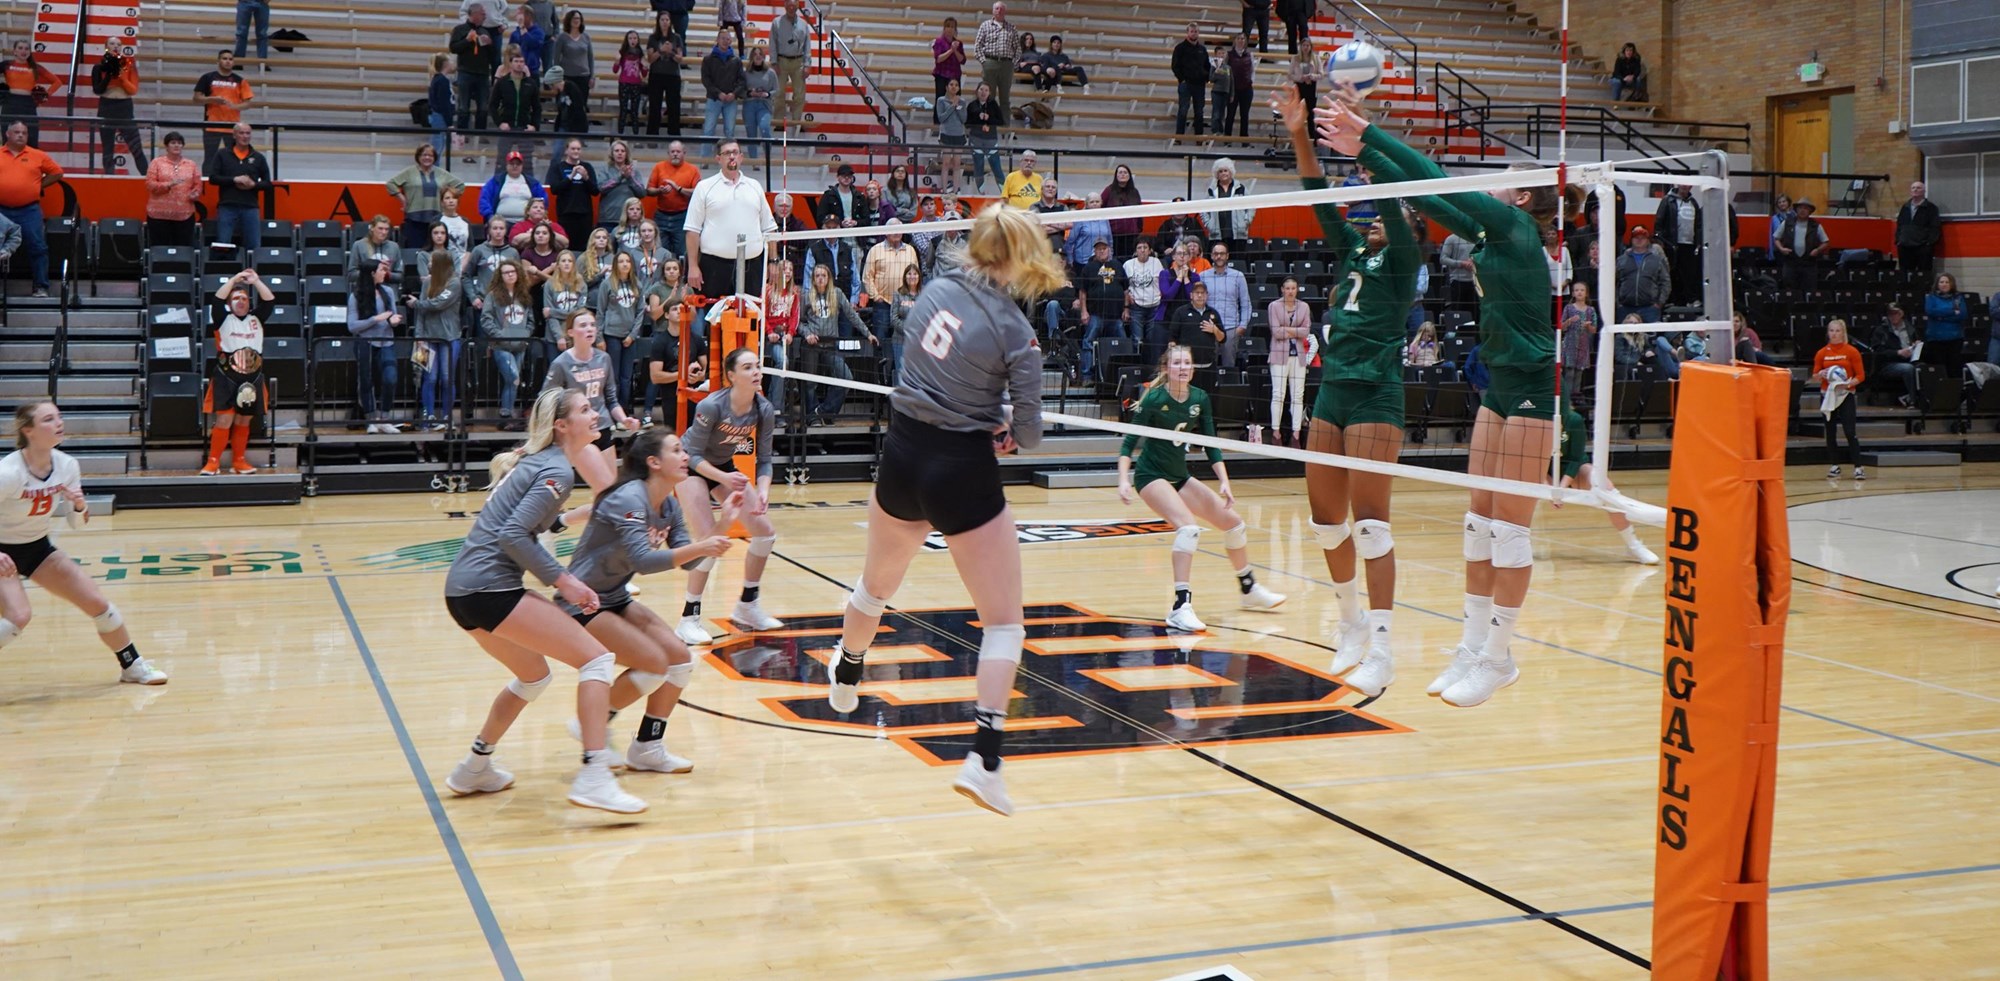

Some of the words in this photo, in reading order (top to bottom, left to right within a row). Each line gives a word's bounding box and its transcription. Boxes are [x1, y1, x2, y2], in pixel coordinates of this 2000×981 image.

[1343, 270, 1364, 311] 2
[920, 309, 963, 360] 6
[586, 381, 600, 398] 18
[28, 494, 54, 517] 13
[1660, 507, 1700, 852] BENGALS
